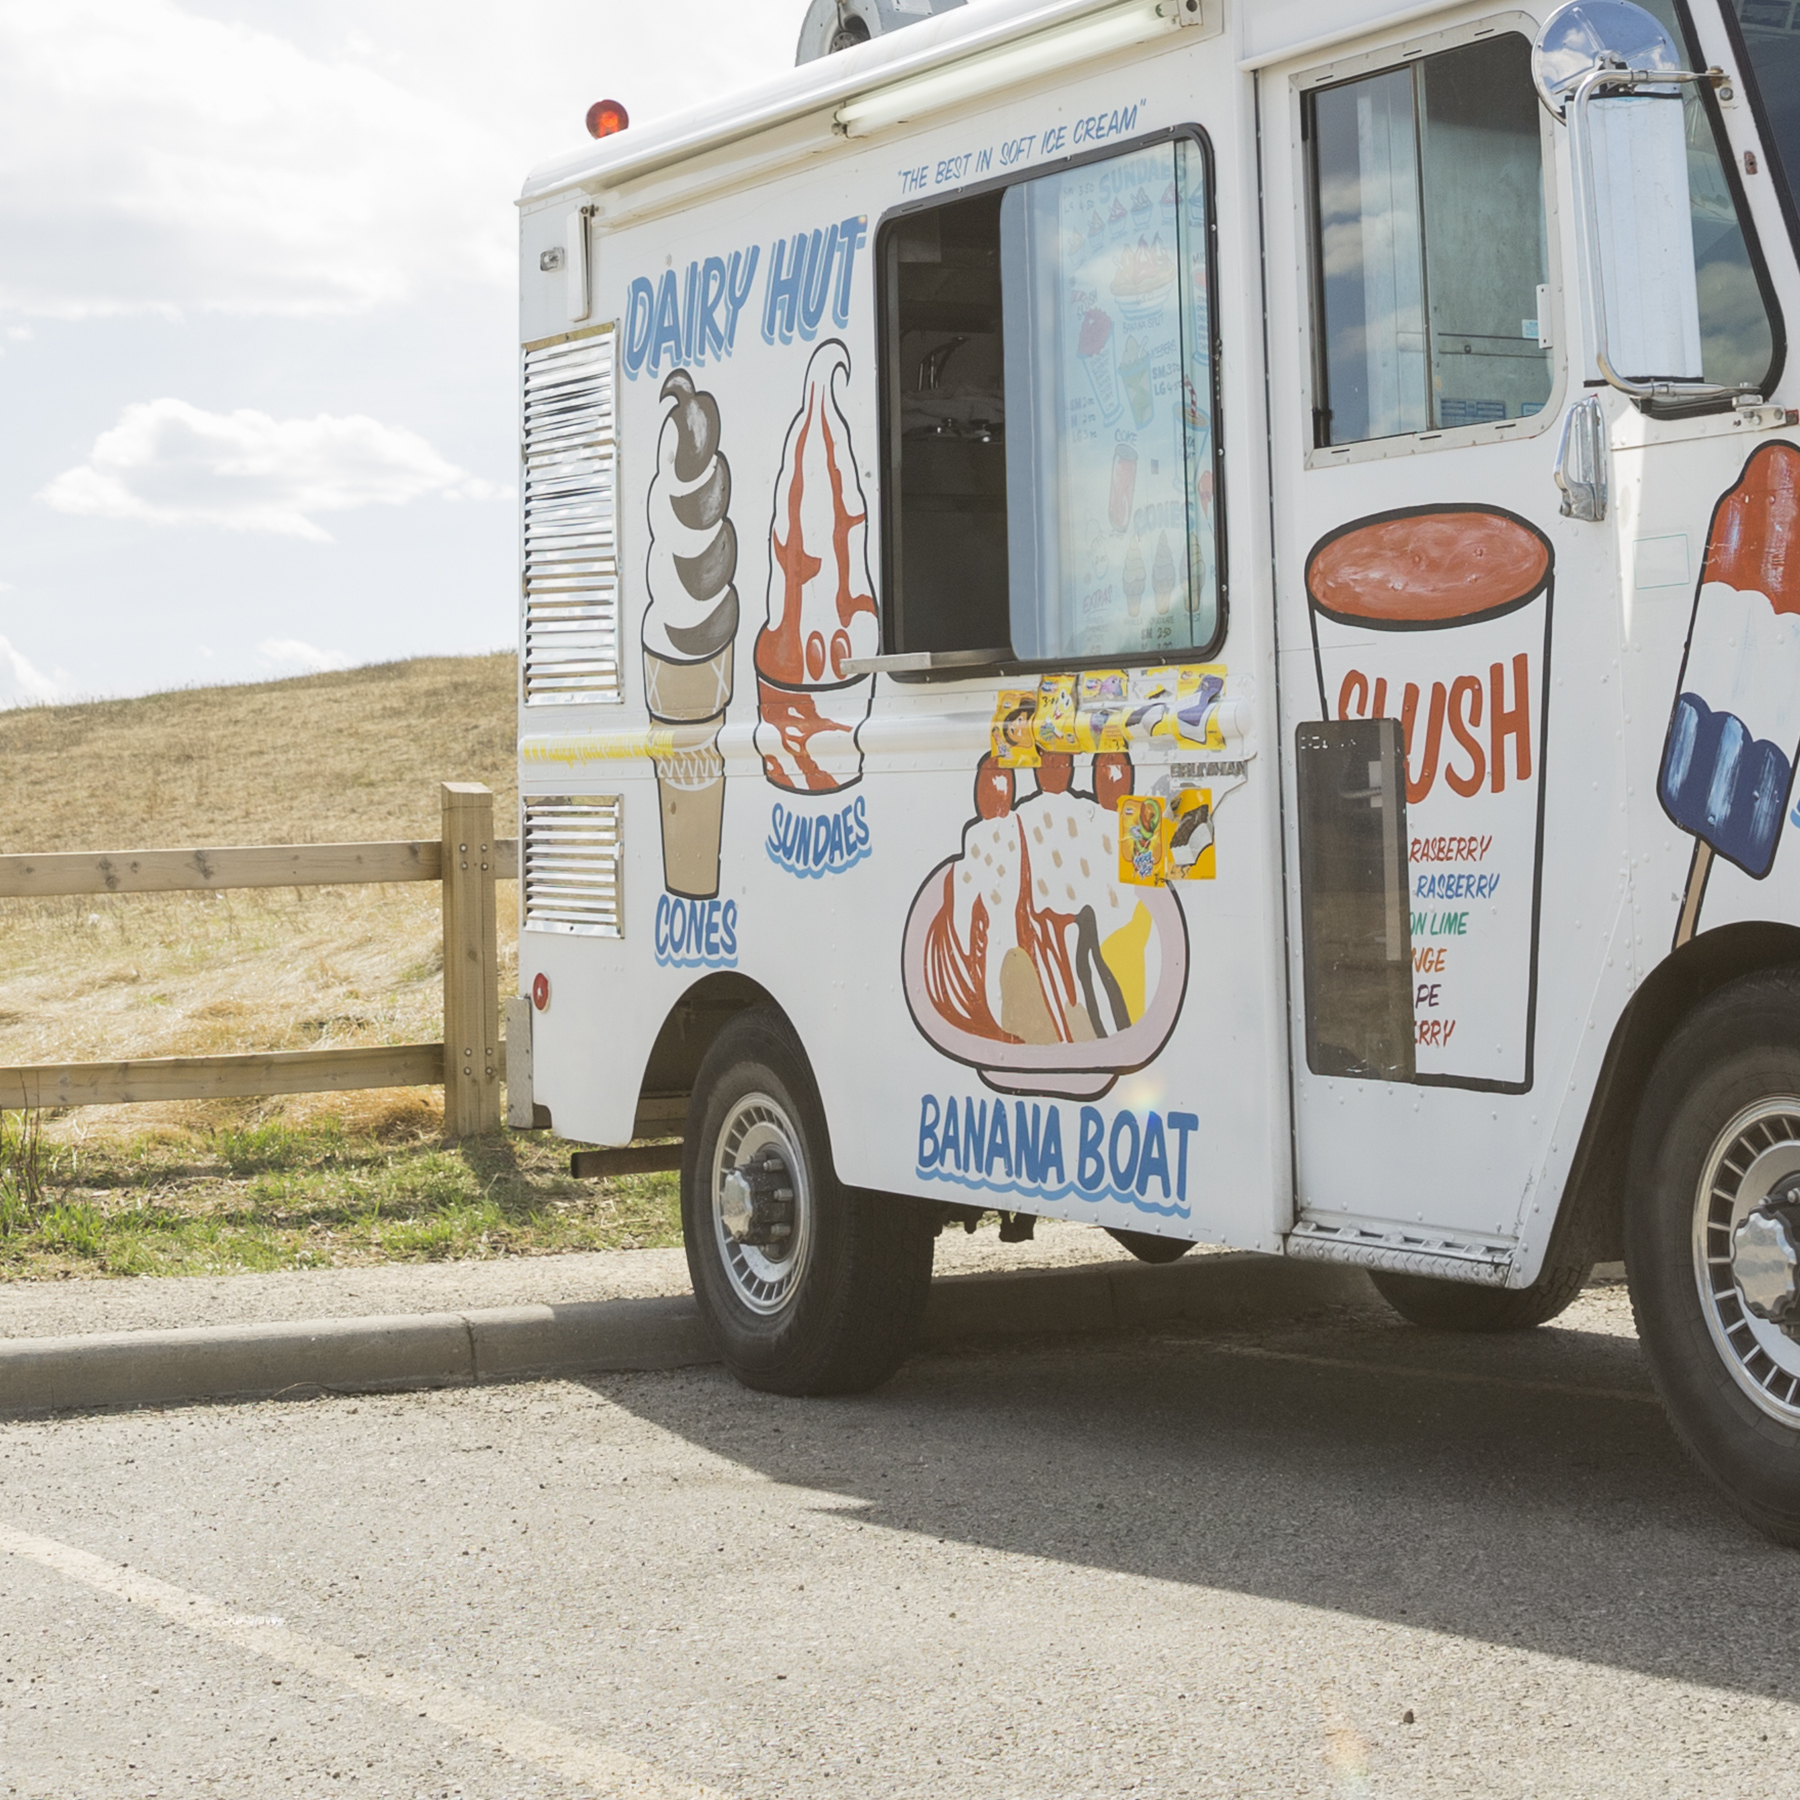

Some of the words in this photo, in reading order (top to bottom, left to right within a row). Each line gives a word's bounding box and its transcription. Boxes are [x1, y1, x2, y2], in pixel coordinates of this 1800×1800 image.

[935, 152, 972, 185] BEST
[975, 147, 993, 173] IN
[999, 134, 1036, 166] SOFT
[1041, 125, 1067, 155] ICE
[1099, 155, 1188, 205] SUNDAES
[623, 244, 760, 381] DAIRY
[761, 213, 868, 347] HUT
[1114, 428, 1138, 447] COKE
[1133, 499, 1196, 537] CONES
[768, 795, 871, 870] SUNDAES
[1409, 835, 1492, 864] RASBERRY
[1416, 873, 1501, 900] RASBERRY
[654, 896, 738, 957] CONES
[1430, 911, 1469, 936] LIME
[917, 1094, 1064, 1185] BANANA
[1076, 1105, 1199, 1203] BOAT
